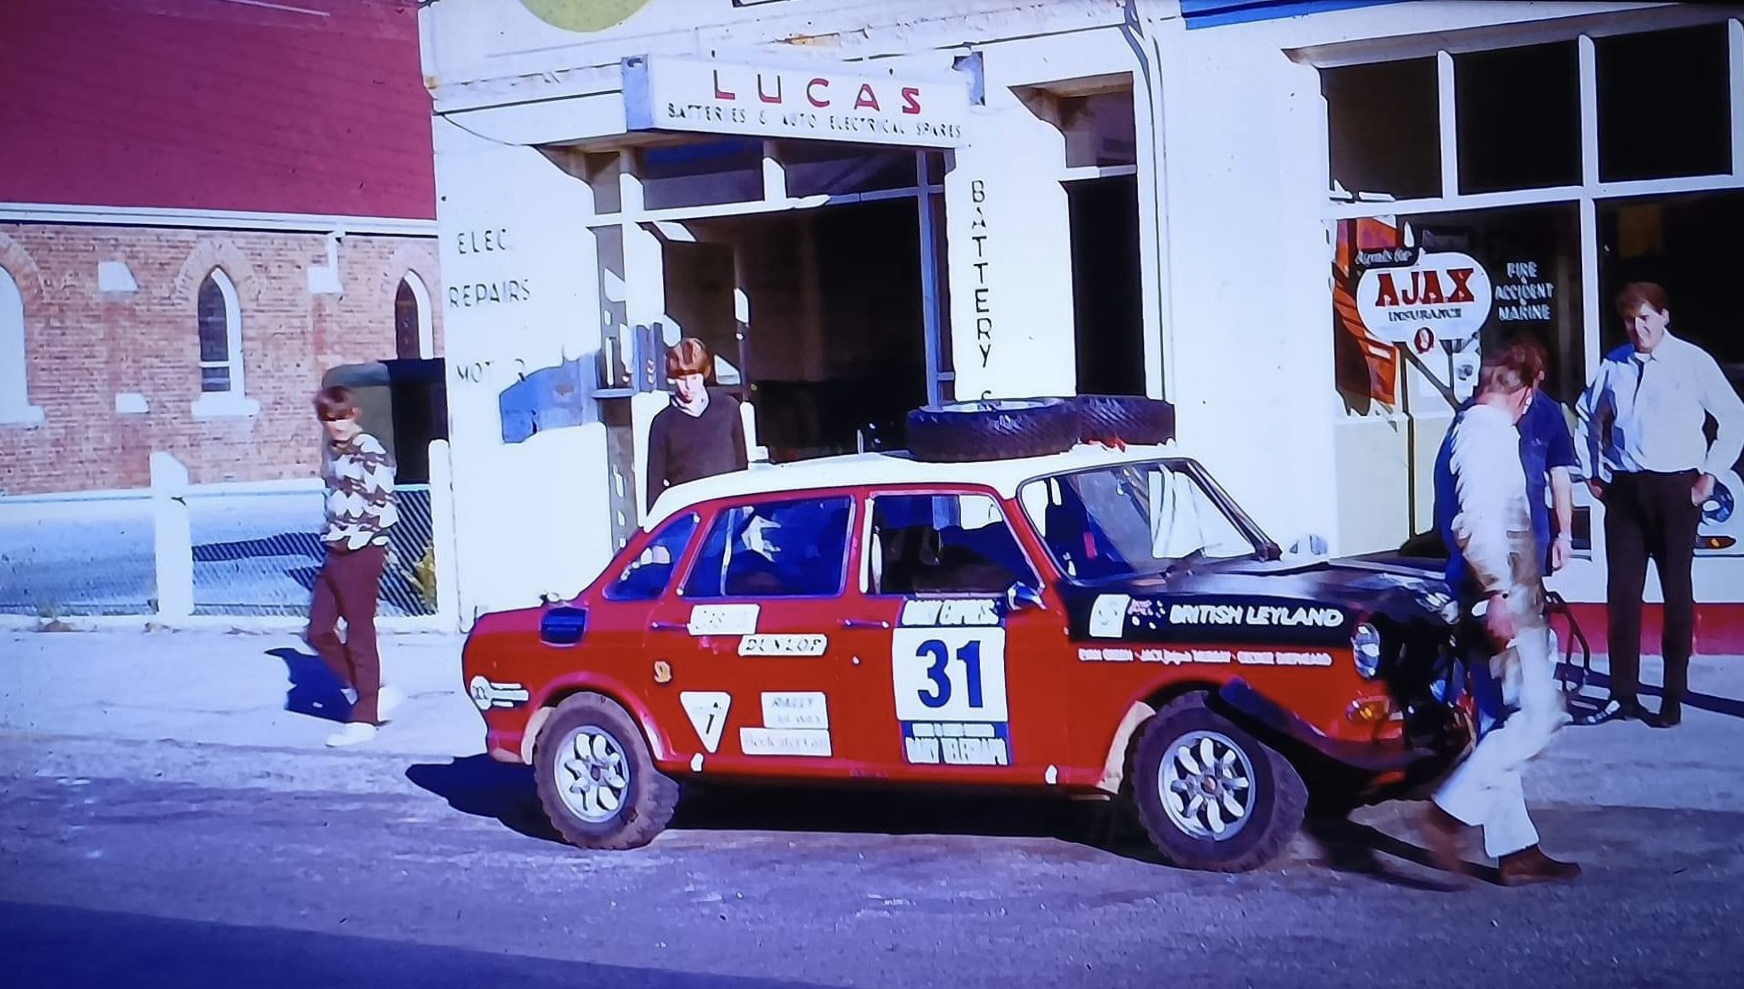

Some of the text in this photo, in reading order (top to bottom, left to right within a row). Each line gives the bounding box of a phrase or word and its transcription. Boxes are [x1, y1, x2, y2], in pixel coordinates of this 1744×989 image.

[713, 69, 921, 115] LUCAS
[667, 102, 746, 123] BATTERIES
[783, 113, 817, 129] AUTO
[830, 115, 905, 134] ELECTRICAL
[916, 122, 961, 138] SPARES
[971, 179, 993, 368] BATTERY
[1507, 262, 1537, 278] FIRE
[449, 279, 531, 308] REPAIRS
[1375, 268, 1475, 307] AJAX
[1494, 283, 1554, 300] ACCIDENT
[1388, 307, 1462, 322] INSURANCE
[1499, 304, 1551, 320] MARINE
[1169, 604, 1344, 628] BRITISH LEYLAND
[745, 638, 822, 652] DUNLOP
[915, 638, 984, 708] 31
